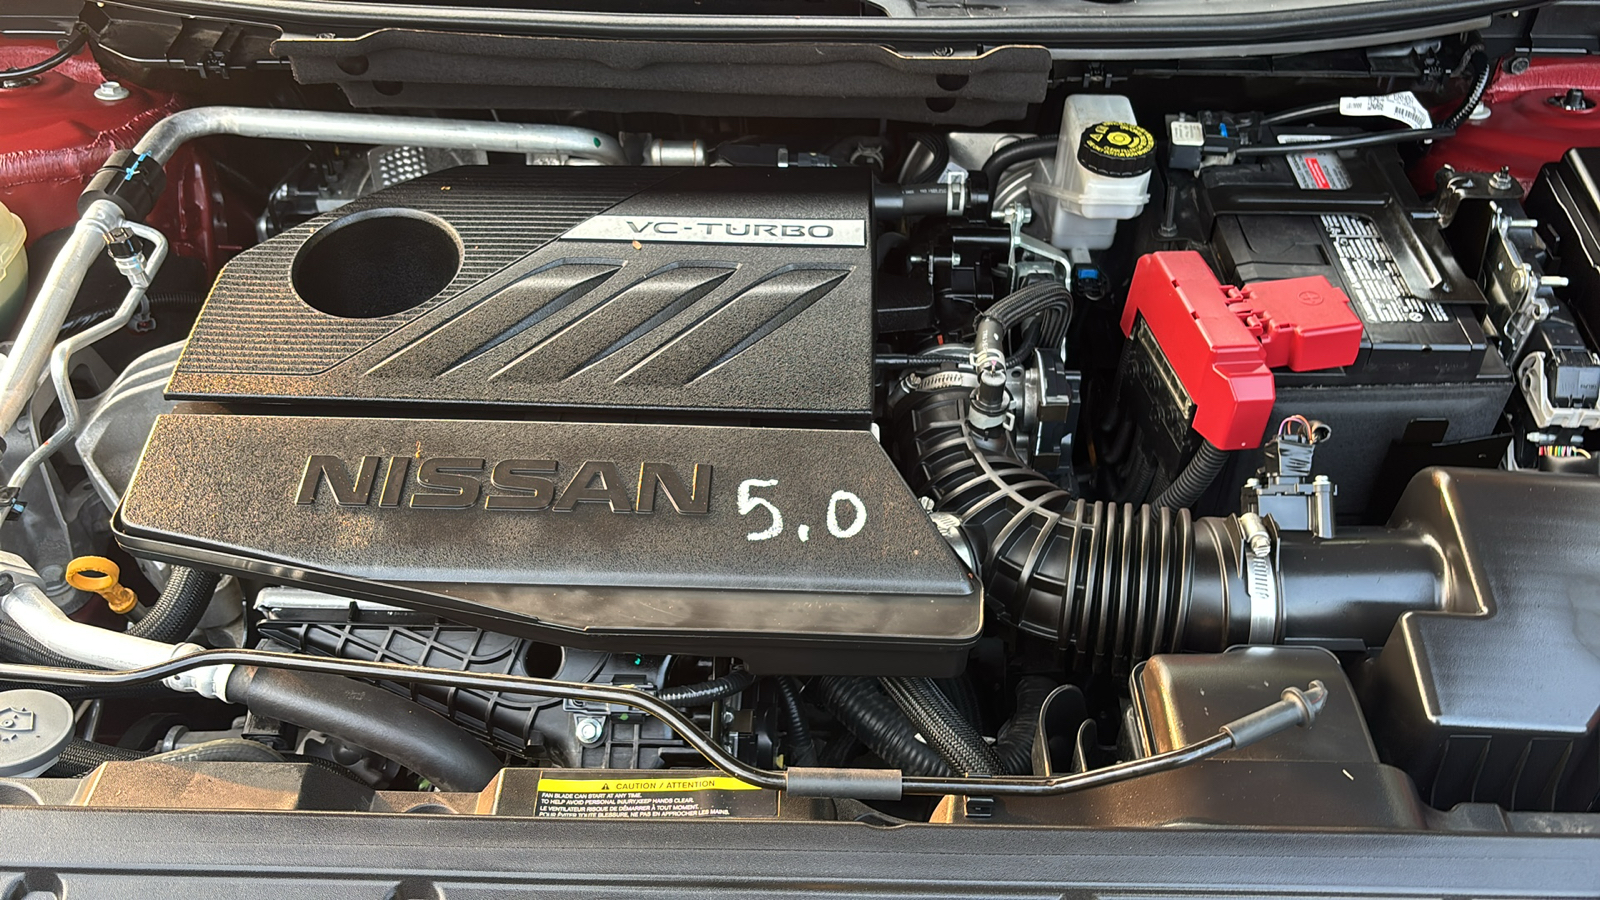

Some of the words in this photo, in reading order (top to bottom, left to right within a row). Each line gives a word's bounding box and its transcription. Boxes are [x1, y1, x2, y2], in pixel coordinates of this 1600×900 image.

[626, 221, 834, 238] VC-TURBO
[294, 454, 713, 514] NISSAN
[737, 478, 868, 542] 5.0
[667, 781, 715, 789] ATTENTION
